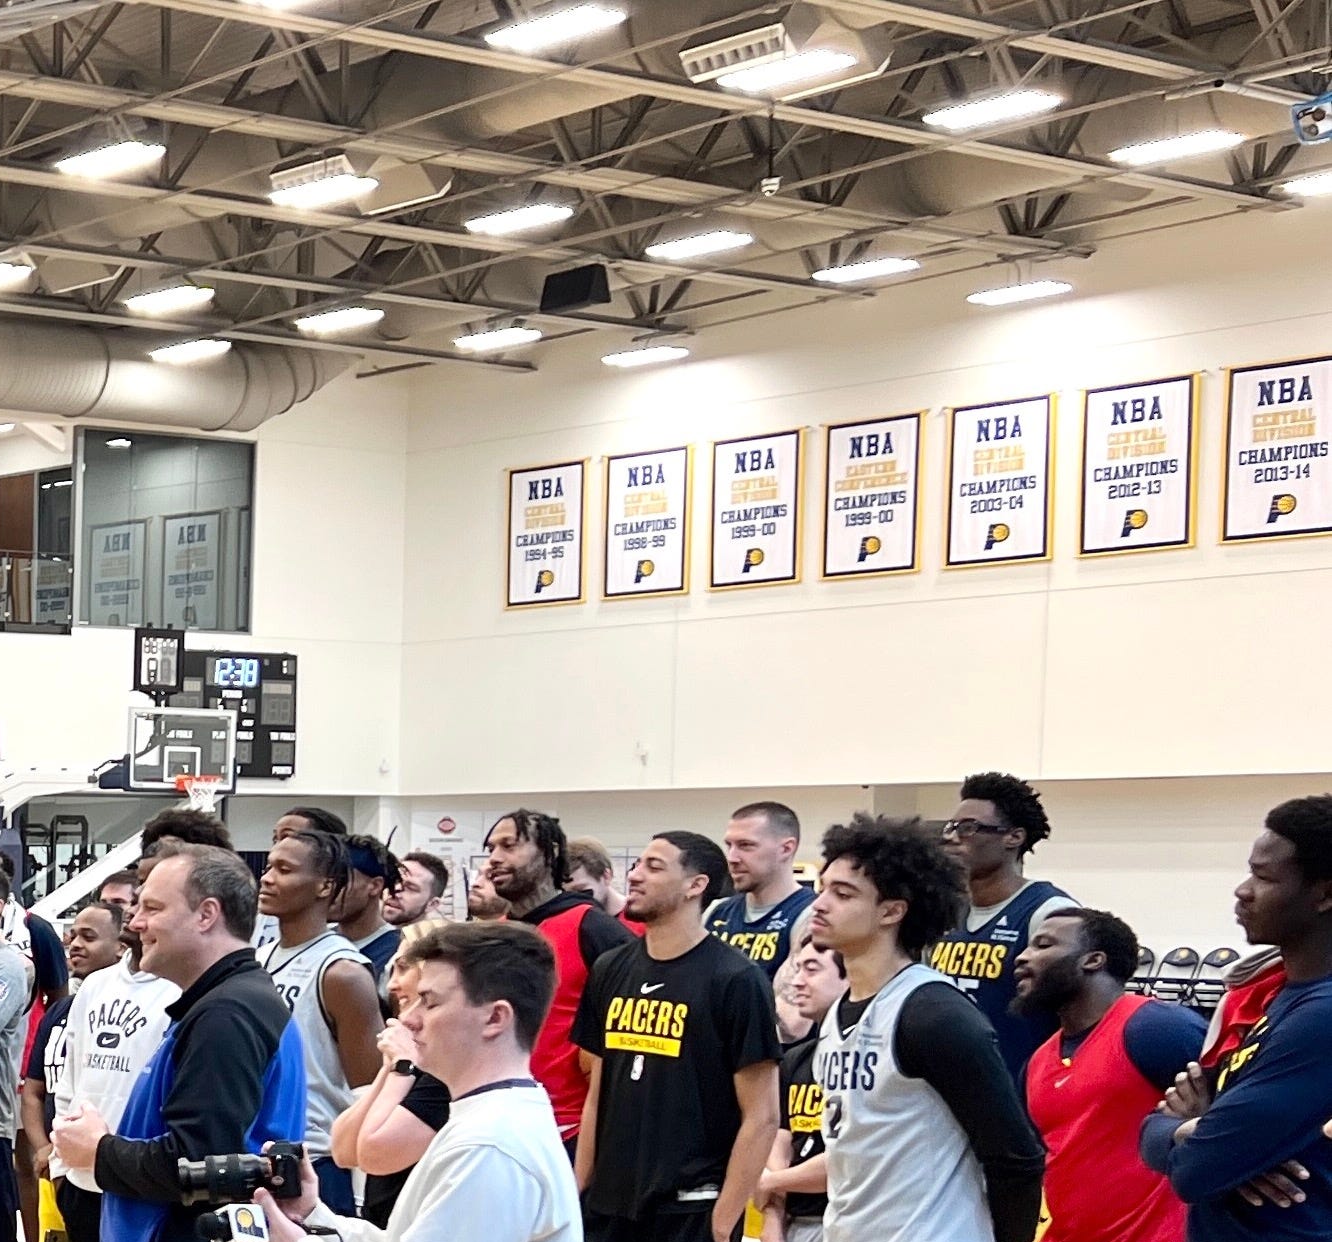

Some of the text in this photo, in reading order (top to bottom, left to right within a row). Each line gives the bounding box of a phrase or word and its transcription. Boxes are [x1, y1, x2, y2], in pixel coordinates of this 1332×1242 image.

[1257, 375, 1313, 406] NBA
[1111, 396, 1163, 426] NBA
[976, 415, 1022, 442] NBA
[849, 432, 894, 459] NBA
[1238, 441, 1329, 466] CHAMPIONS
[734, 449, 775, 473] NBA
[1093, 459, 1178, 482] CHAMPIONS
[627, 464, 665, 487] NBA
[1254, 464, 1311, 483] 2013-14
[528, 477, 564, 500] NBA
[960, 475, 1037, 497] CHAMPIONS
[1108, 480, 1162, 499] 2012-13
[834, 490, 907, 511] CHAMPIONS
[970, 495, 1024, 514] 2003-04
[721, 504, 787, 524] CHAMPIONS
[614, 518, 676, 536] CHAMPIONS
[516, 530, 574, 548] CHAMPIONS
[214, 658, 260, 688] 12:38
[930, 941, 1008, 979] PACERS
[88, 998, 148, 1038] PACERS
[605, 996, 689, 1038] PACERS
